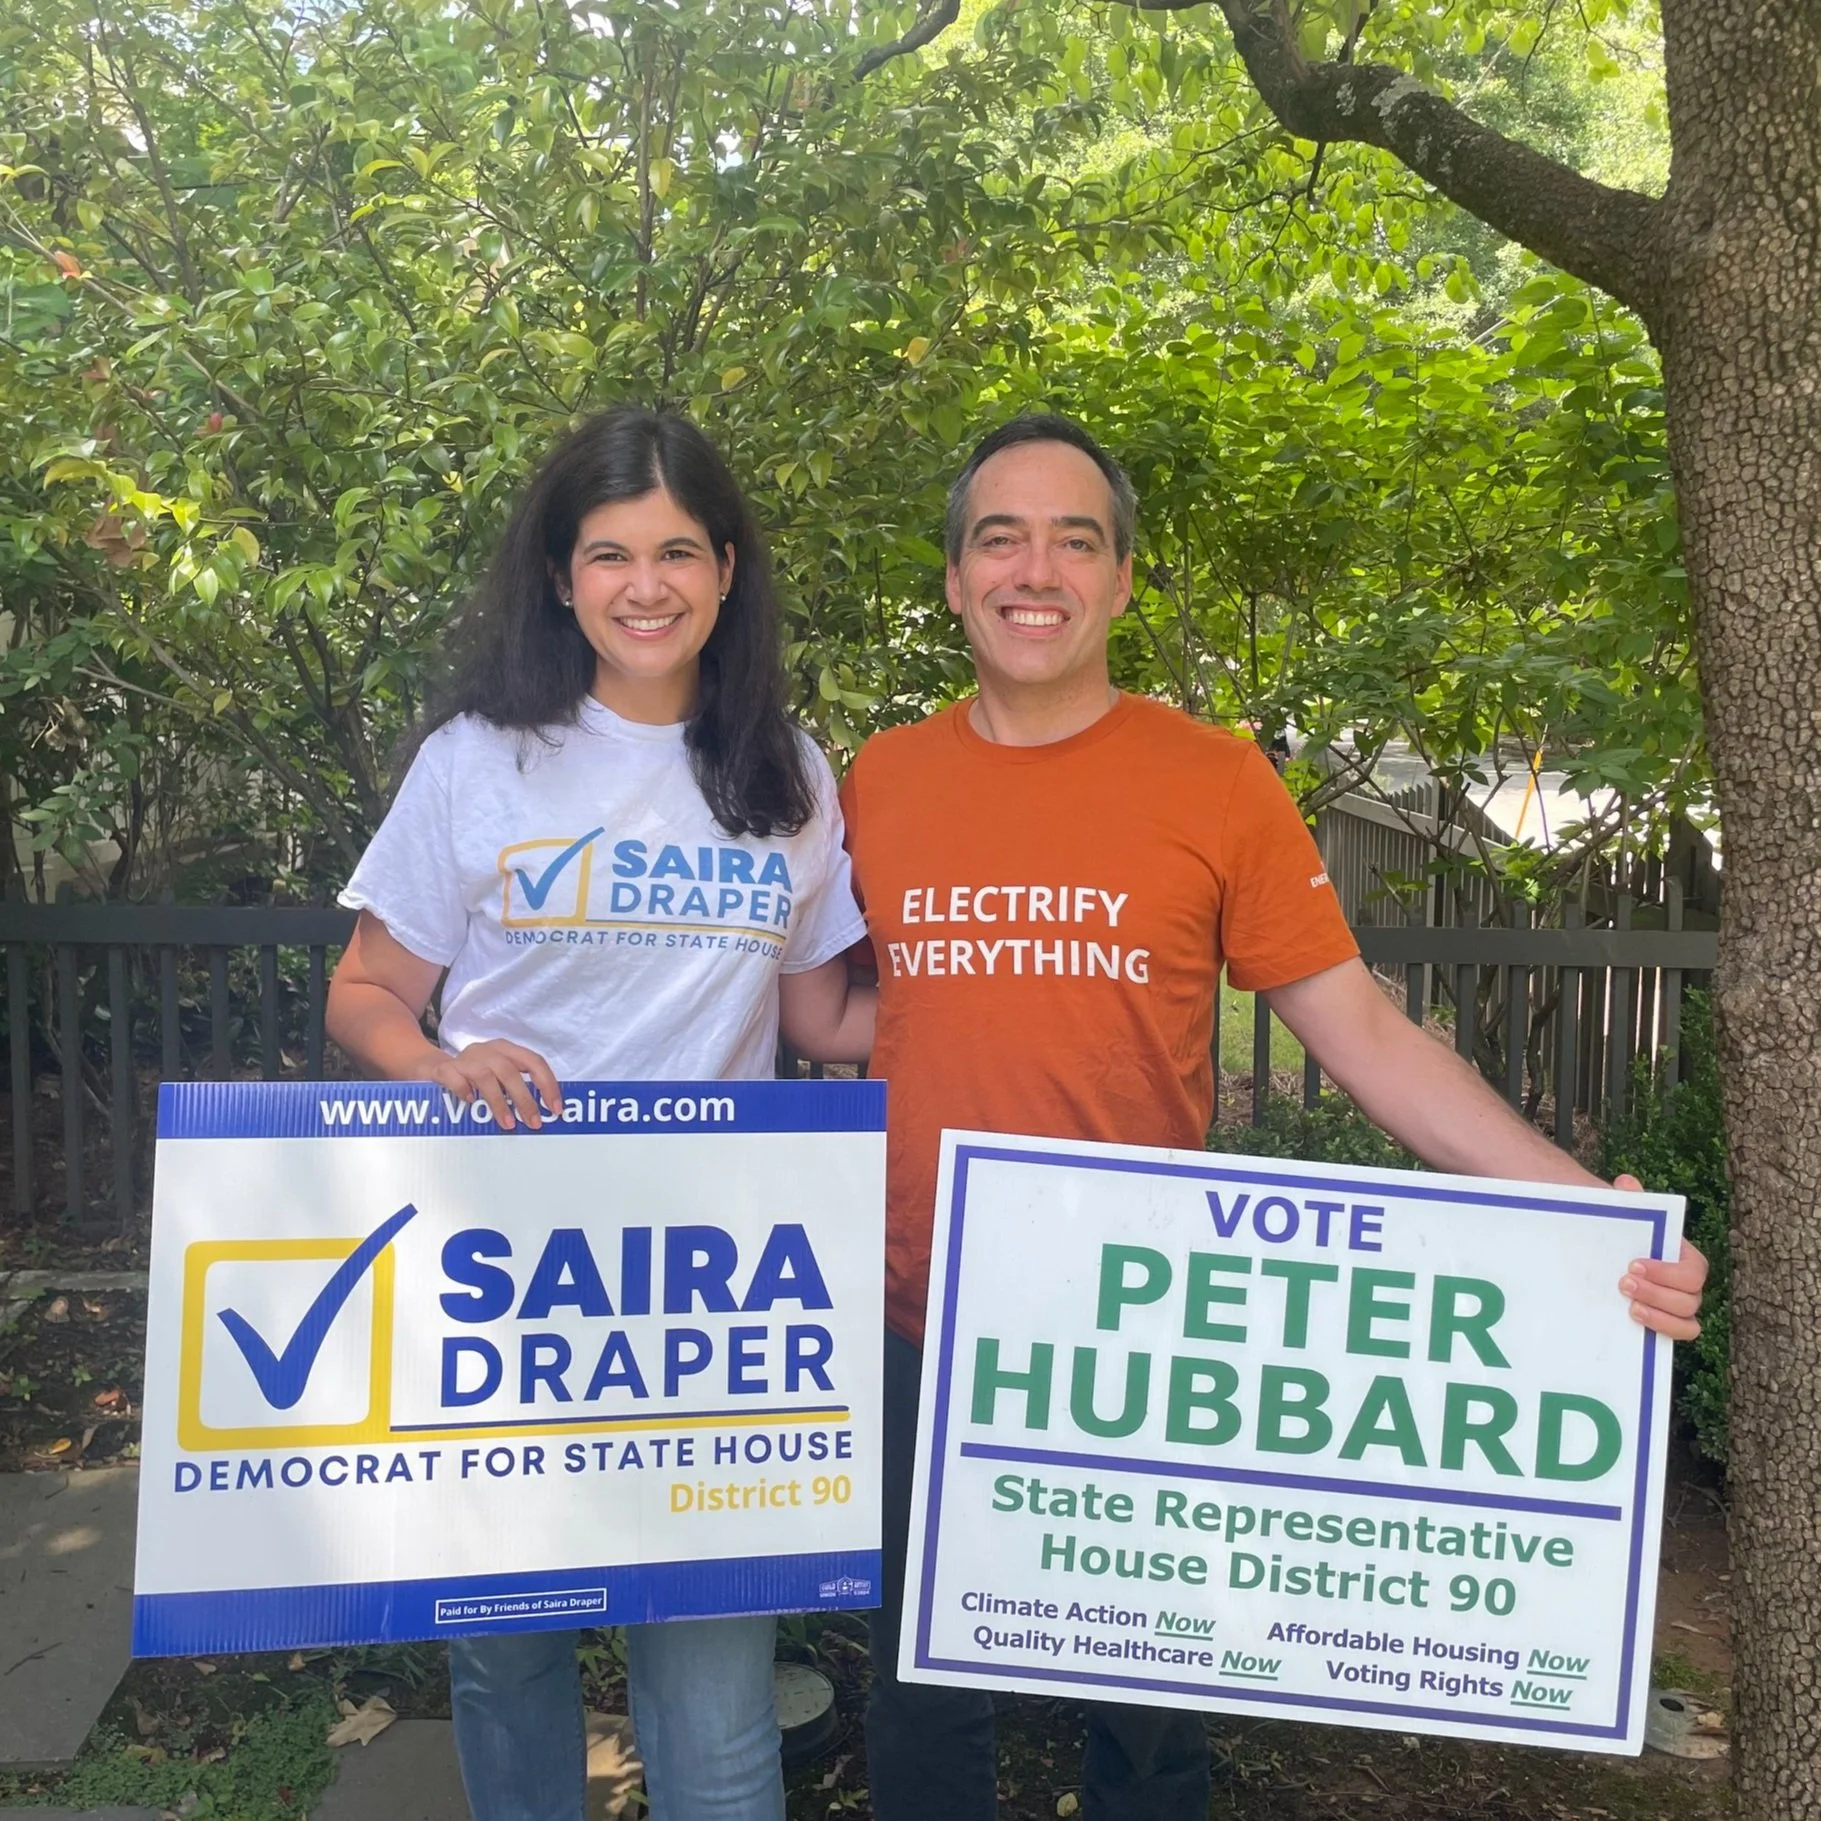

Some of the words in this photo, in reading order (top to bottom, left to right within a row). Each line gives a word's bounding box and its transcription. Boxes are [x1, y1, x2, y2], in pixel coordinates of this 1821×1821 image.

[611, 839, 793, 894] SAIRA
[610, 882, 792, 929] DRAPER
[902, 885, 1129, 927] ELECTRIFY
[505, 930, 609, 945] DEMOCRAT
[616, 931, 657, 947] FOR
[665, 934, 728, 949] STATE
[735, 938, 784, 961] HOUSE
[887, 939, 1151, 984] EVERYTHING
[1205, 1190, 1386, 1253] VOTE
[439, 1223, 834, 1323] SAIRA
[1096, 1242, 1513, 1370] PETER
[440, 1324, 835, 1408] DRAPER
[969, 1336, 1623, 1483] HUBBARD
[174, 1451, 442, 1493] DEMOCRAT
[460, 1445, 547, 1479] FOR
[563, 1437, 695, 1474] STATE
[714, 1430, 853, 1466] HOUSE
[670, 1481, 802, 1512] District
[811, 1475, 852, 1504] 90
[991, 1474, 1135, 1524] State
[1154, 1489, 1575, 1568] Representative
[1040, 1532, 1209, 1585] House
[1228, 1551, 1430, 1609] District
[1448, 1574, 1517, 1617] 90
[440, 1606, 461, 1617] Paid
[463, 1606, 477, 1616] for
[480, 1604, 492, 1616] By
[494, 1601, 529, 1613] Friends
[532, 1601, 541, 1610] of
[544, 1599, 567, 1609] Saira
[570, 1597, 602, 1608] Draper
[961, 1592, 1059, 1619] Climate
[1065, 1602, 1148, 1628] Action
[1155, 1611, 1217, 1635] Now
[973, 1625, 1067, 1657] Quality
[1073, 1635, 1214, 1667] Healthcare
[1220, 1650, 1283, 1674] Now
[1267, 1622, 1405, 1654] Affordable
[1412, 1637, 1520, 1671] Housing
[1528, 1649, 1591, 1673] Now
[1326, 1660, 1411, 1692] Voting
[1419, 1670, 1504, 1698] Rights
[1510, 1680, 1574, 1705] Now
